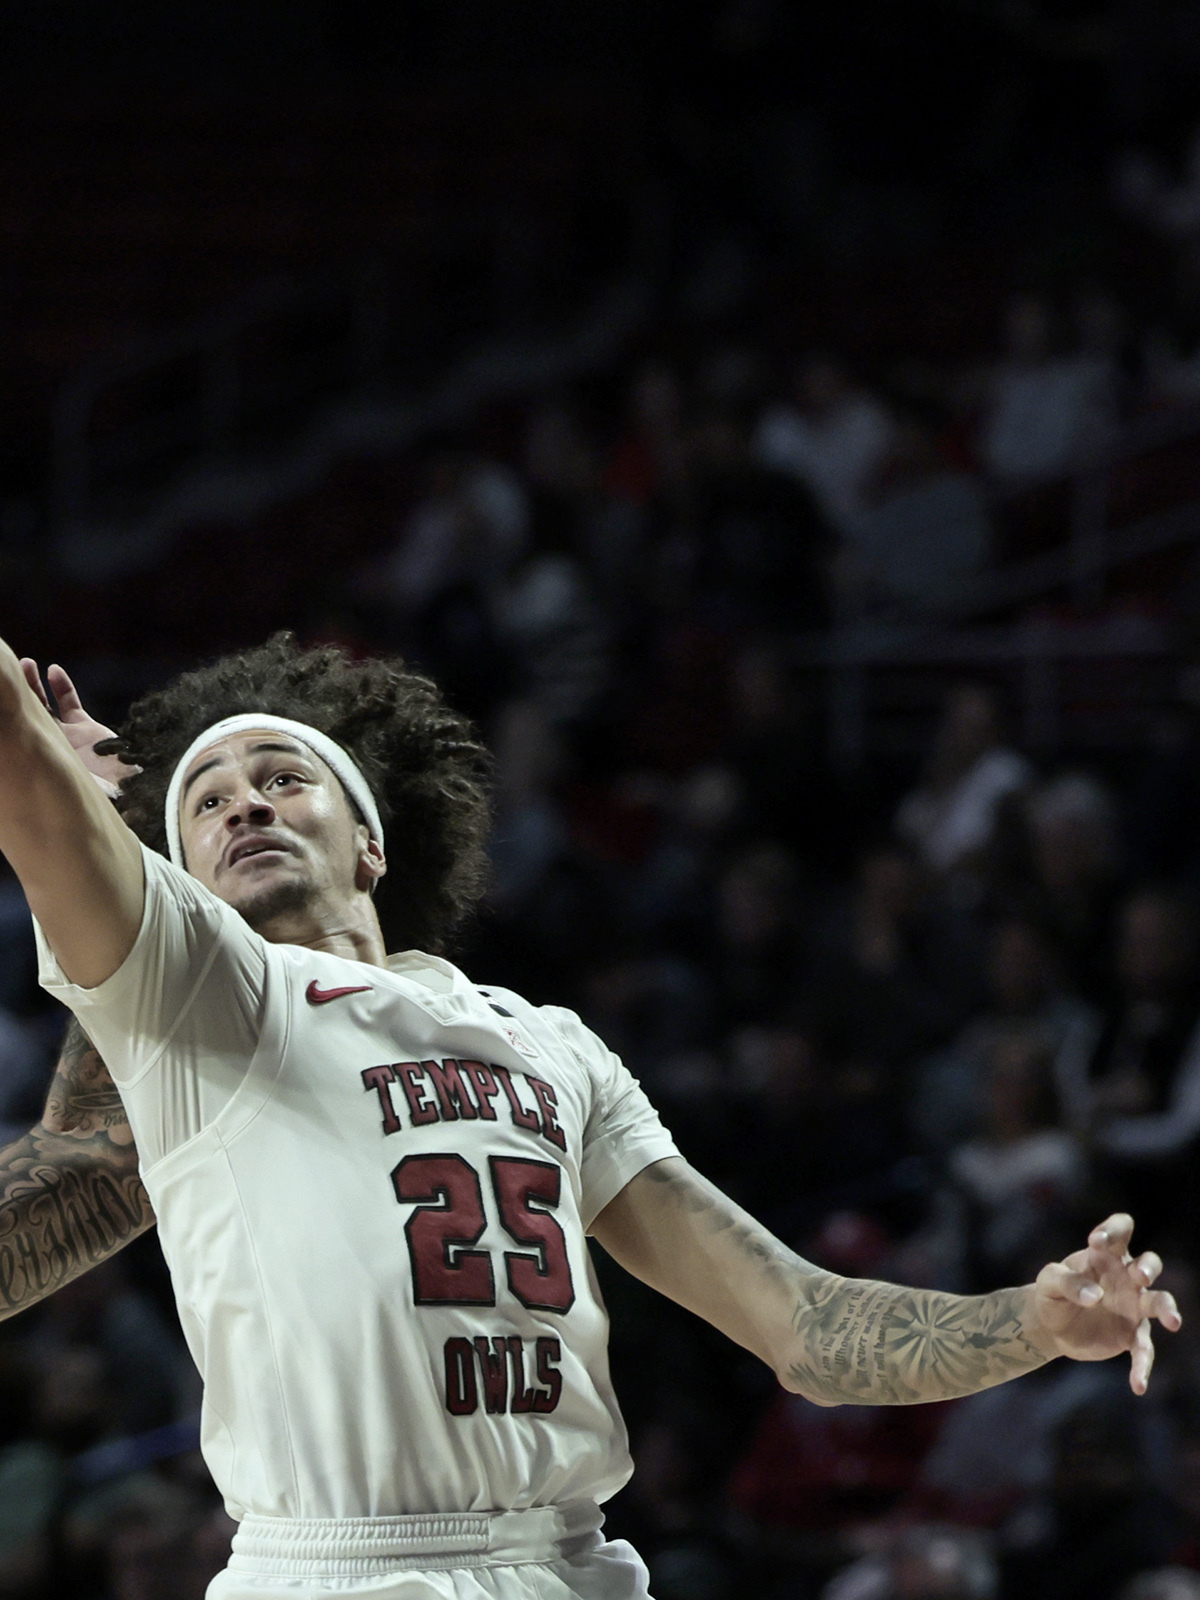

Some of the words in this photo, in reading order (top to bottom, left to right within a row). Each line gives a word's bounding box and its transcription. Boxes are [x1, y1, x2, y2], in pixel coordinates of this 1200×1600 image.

[361, 1058, 567, 1152] TEMPLE
[390, 1153, 576, 1315] 25
[443, 1335, 562, 1416] OWLS
